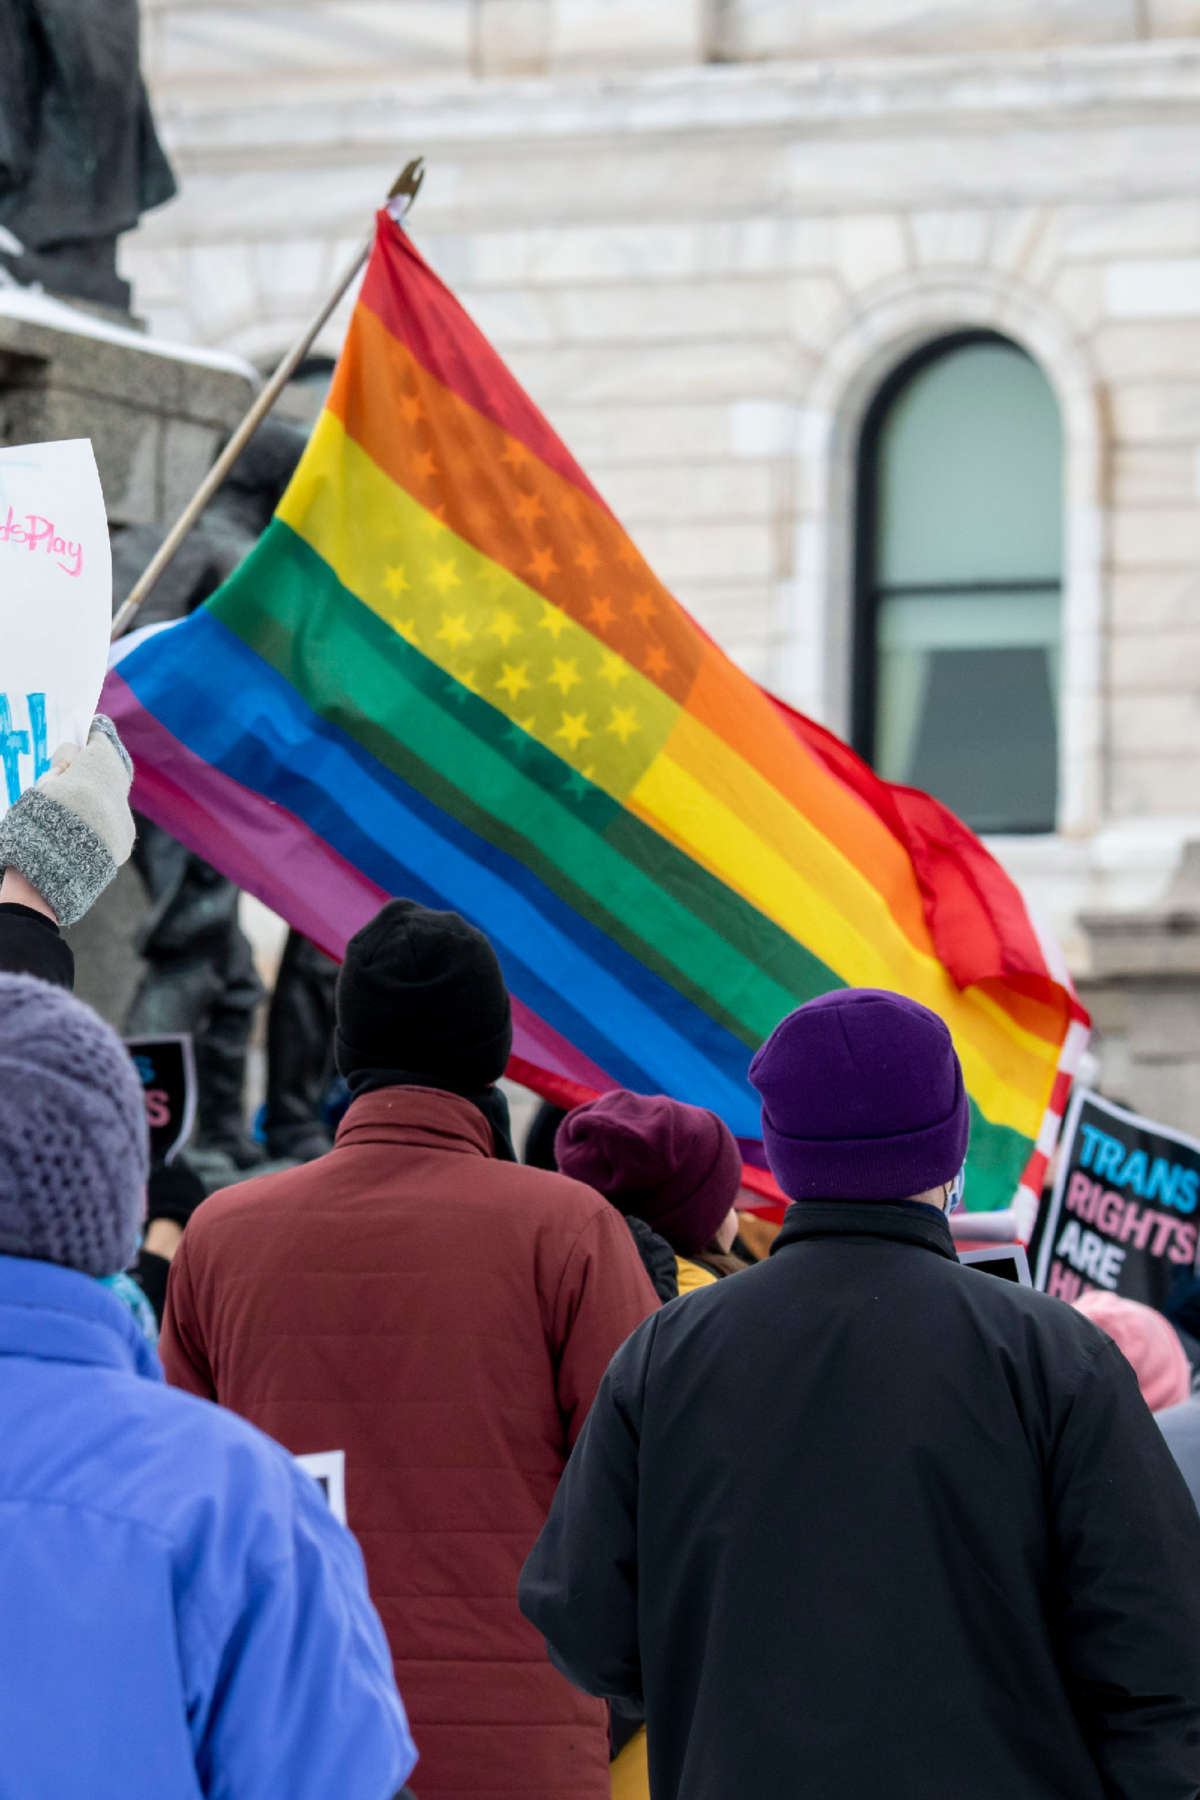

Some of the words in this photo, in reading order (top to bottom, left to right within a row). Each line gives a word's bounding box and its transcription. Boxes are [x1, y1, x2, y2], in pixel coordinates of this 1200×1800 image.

[1078, 1122, 1200, 1214] TRANS
[1055, 1220, 1127, 1290] ARE
[1065, 1169, 1197, 1264] RIGHTS
